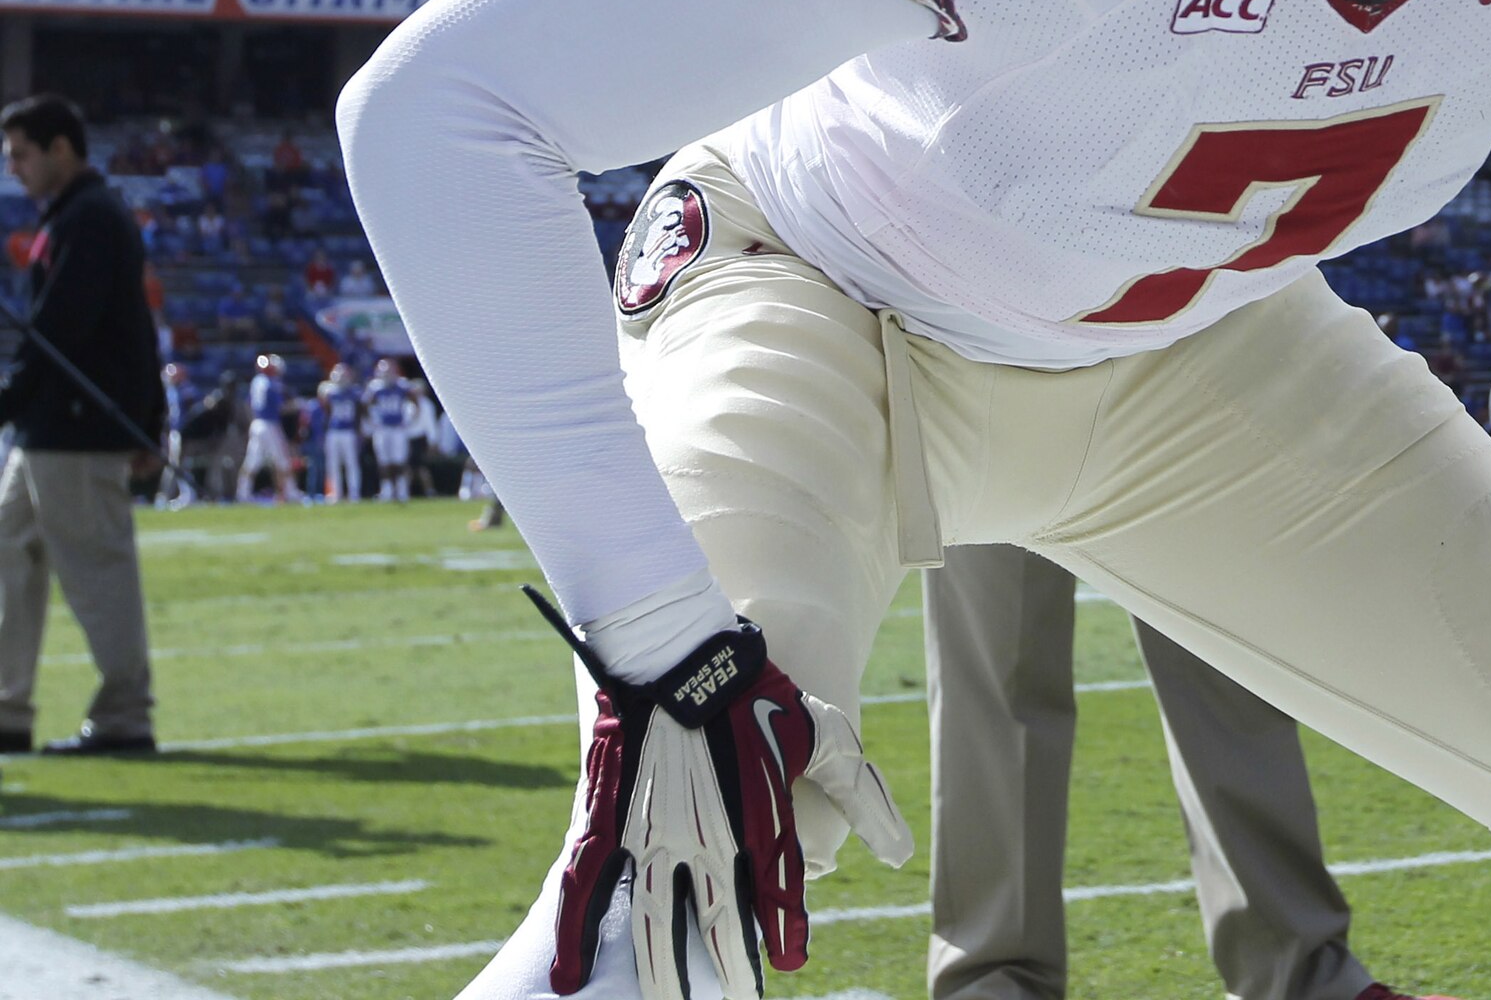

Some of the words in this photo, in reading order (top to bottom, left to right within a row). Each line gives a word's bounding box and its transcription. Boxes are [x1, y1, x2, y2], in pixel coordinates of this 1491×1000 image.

[1290, 54, 1395, 99] FSU
[1060, 93, 1446, 327] 7
[711, 645, 735, 669] THE
[673, 663, 713, 703] SPEAR
[690, 658, 739, 706] FEAR
